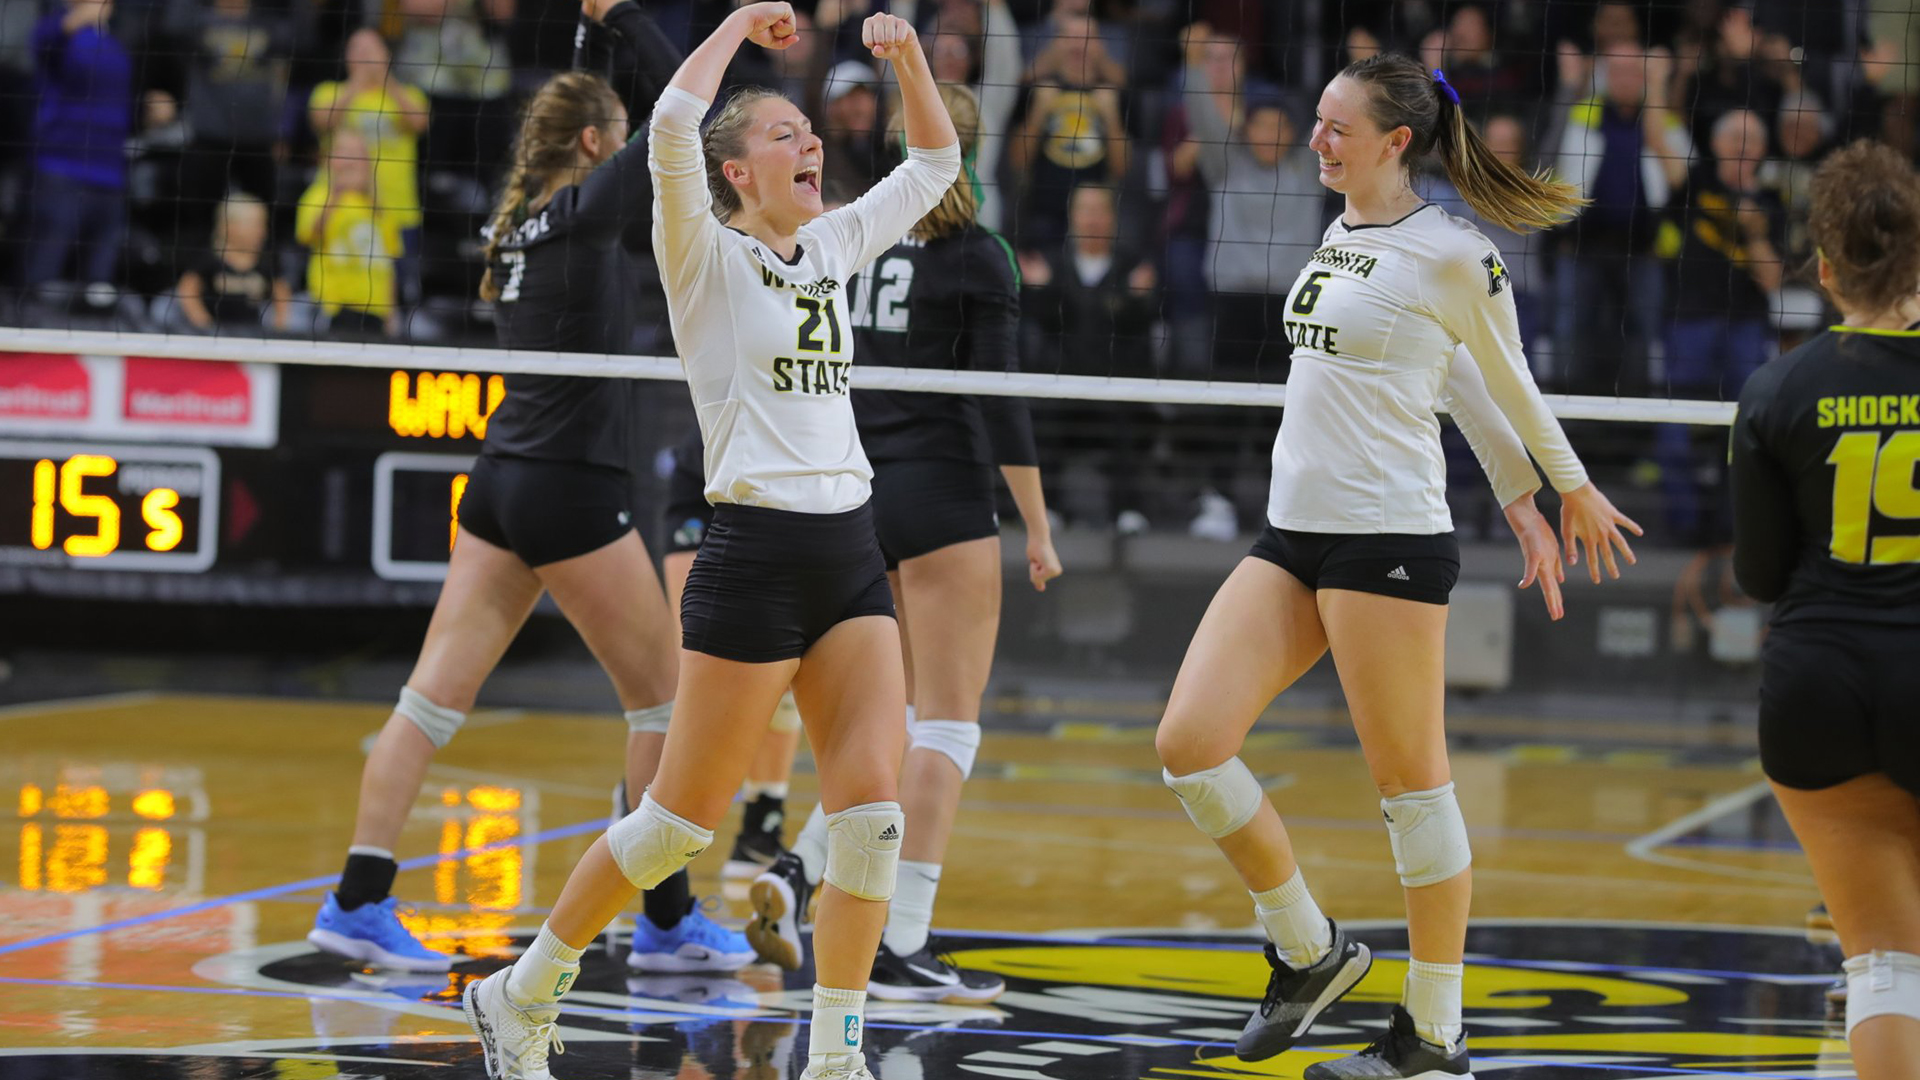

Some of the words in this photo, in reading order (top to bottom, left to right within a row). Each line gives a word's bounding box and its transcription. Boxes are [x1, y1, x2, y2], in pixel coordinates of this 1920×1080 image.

[500, 249, 526, 302] 7
[851, 257, 914, 332] 12
[1291, 270, 1332, 315] 6
[796, 296, 841, 353] 21
[31, 454, 120, 557] 15
[1825, 430, 1920, 566] 19
